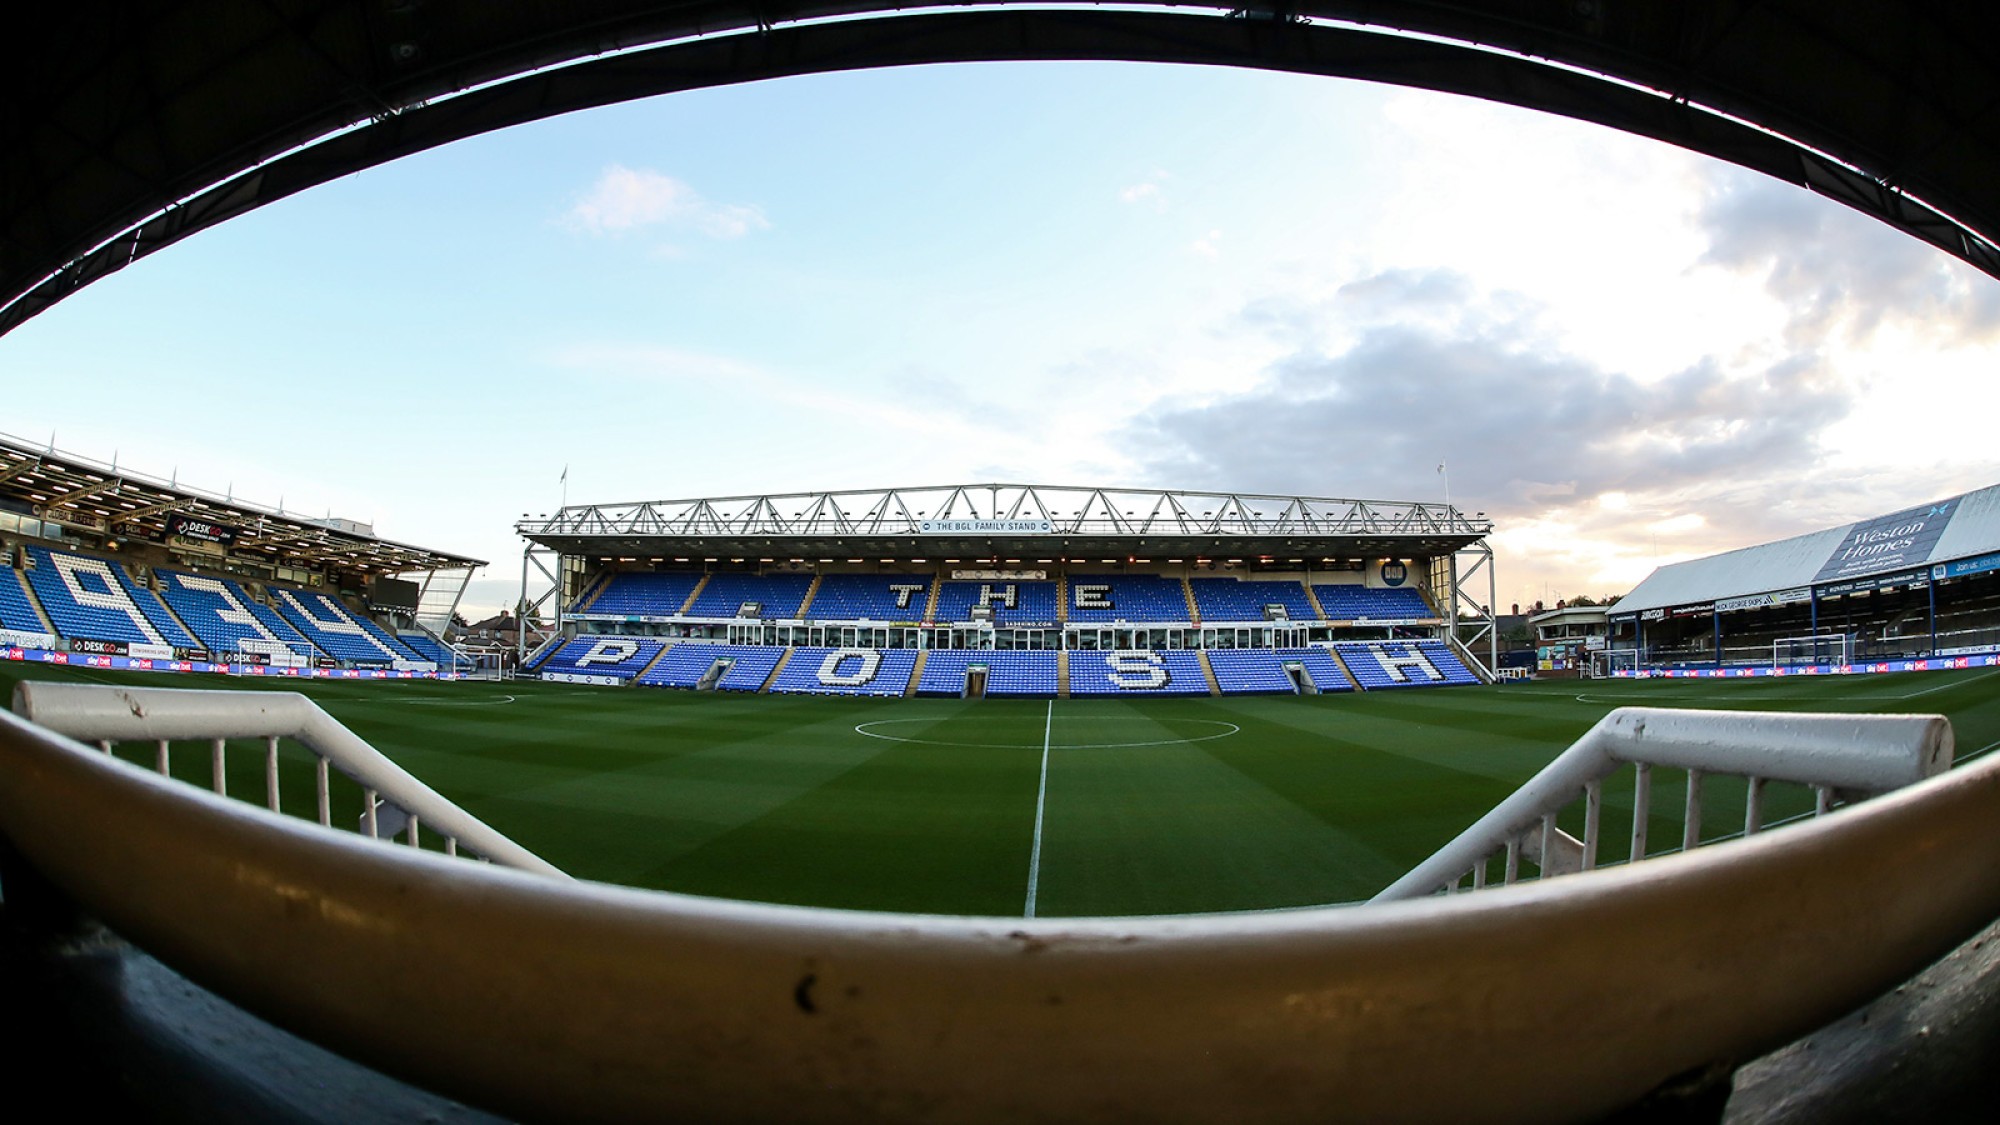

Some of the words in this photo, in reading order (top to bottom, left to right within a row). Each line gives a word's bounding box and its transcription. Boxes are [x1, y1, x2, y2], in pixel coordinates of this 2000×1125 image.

[937, 522, 952, 531] THE
[955, 522, 971, 531] BGL
[975, 522, 1005, 531] FAMILY
[1009, 522, 1036, 531] STAND
[1854, 521, 1925, 545] Weston
[1840, 538, 1914, 560] Homes
[84, 641, 128, 654] DESKGO.com
